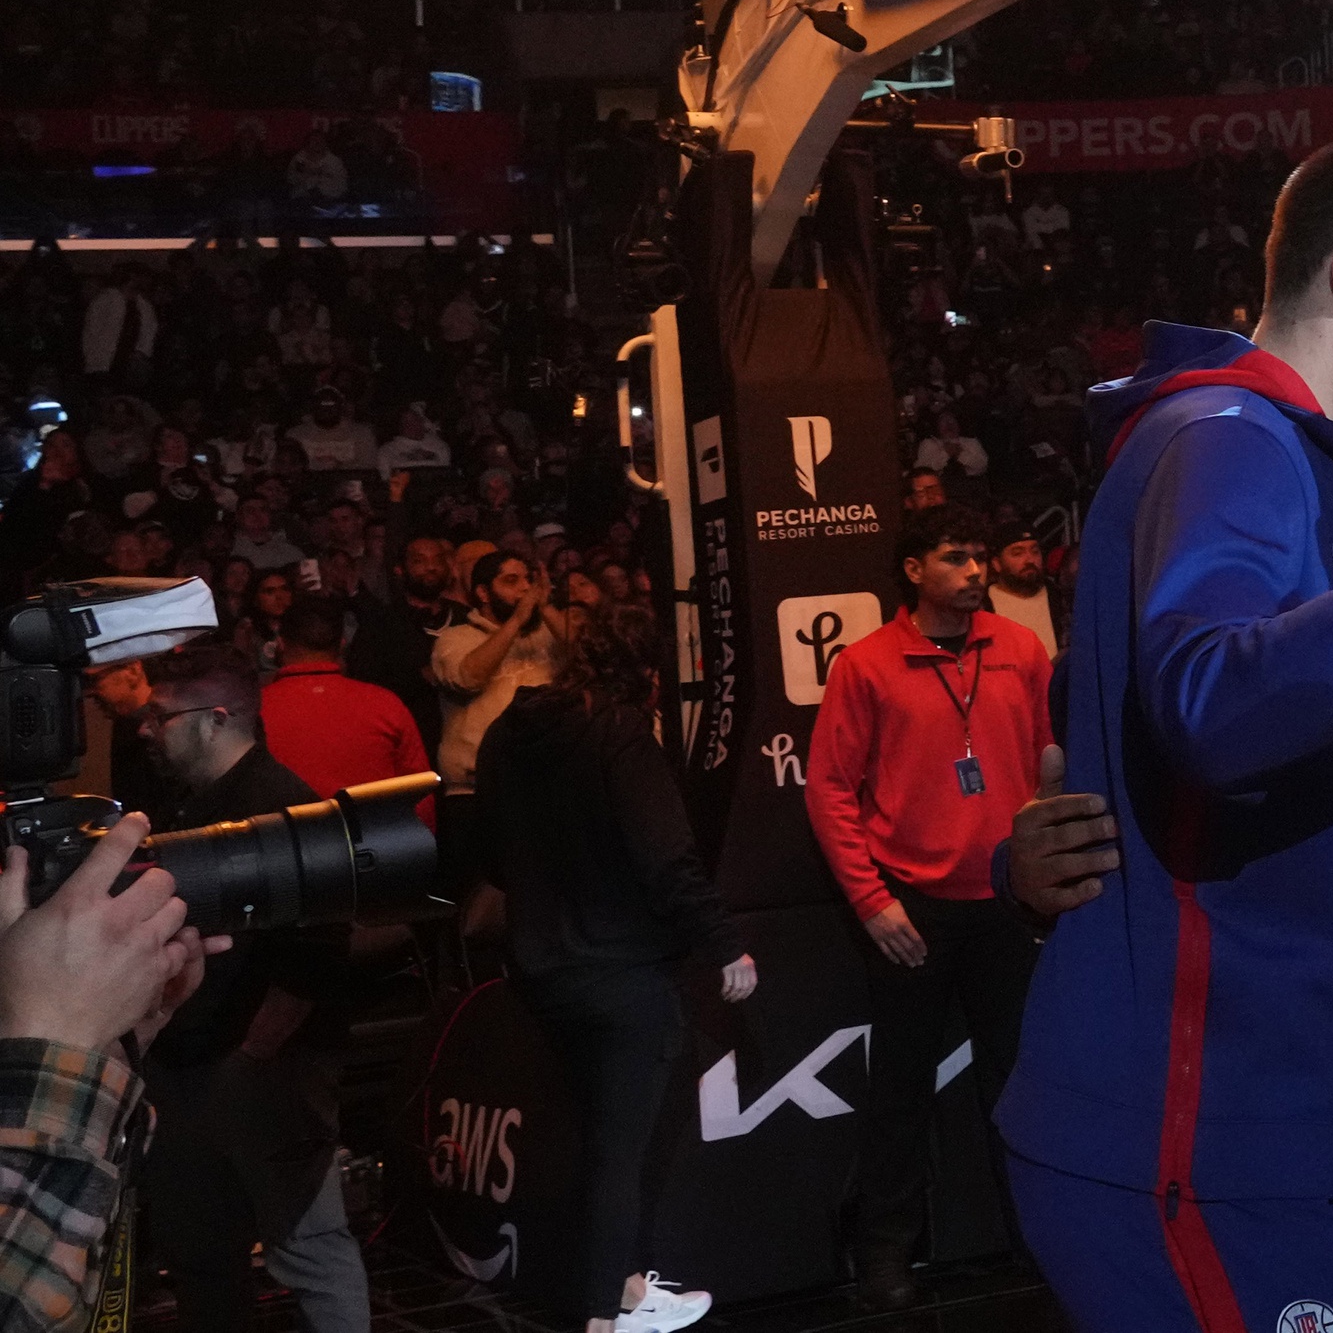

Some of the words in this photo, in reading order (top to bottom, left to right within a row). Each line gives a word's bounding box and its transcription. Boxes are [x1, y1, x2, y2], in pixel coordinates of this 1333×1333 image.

[756, 503, 878, 528] PECHANGA
[757, 526, 816, 541] RESORT
[824, 522, 880, 536] CASINO
[713, 517, 735, 768] PECHANGA
